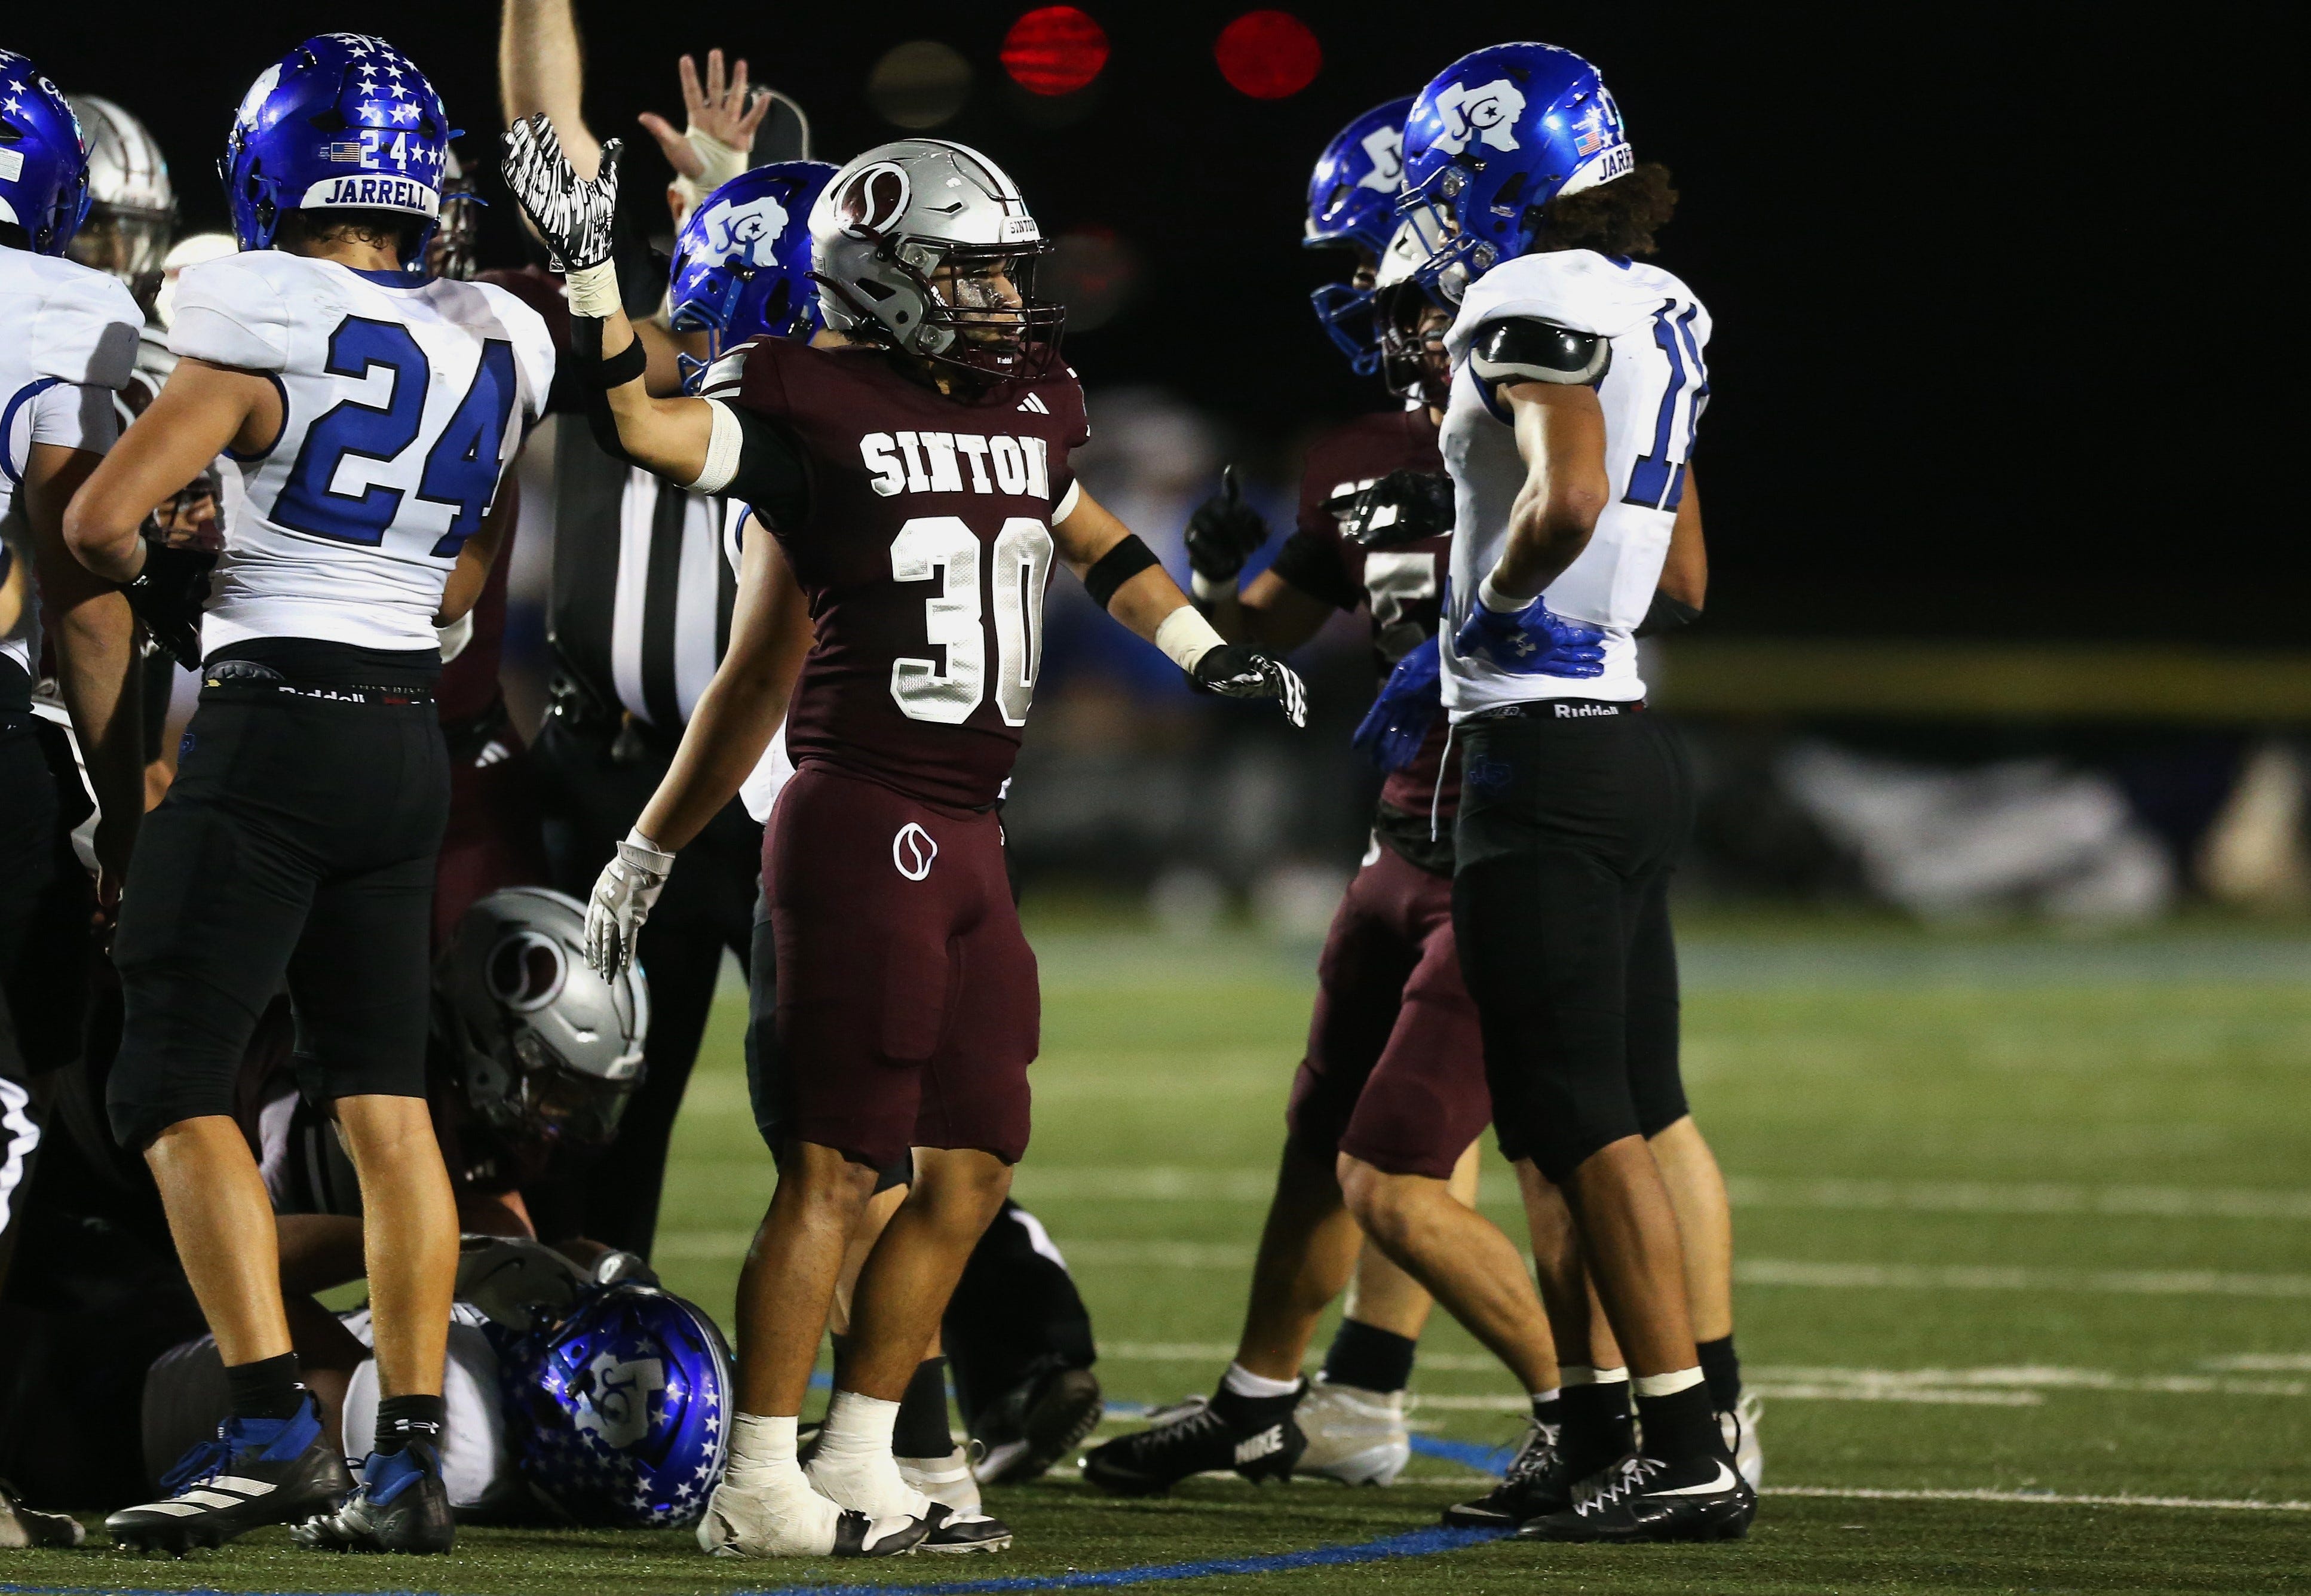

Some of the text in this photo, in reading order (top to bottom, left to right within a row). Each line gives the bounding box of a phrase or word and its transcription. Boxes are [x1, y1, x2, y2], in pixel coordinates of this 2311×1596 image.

[360, 130, 407, 170] 24
[325, 179, 426, 211] JARRELL
[268, 314, 517, 558] 24
[859, 431, 1049, 501] SINTON
[890, 516, 1055, 728] 30
[1234, 1424, 1283, 1466] NIKE
